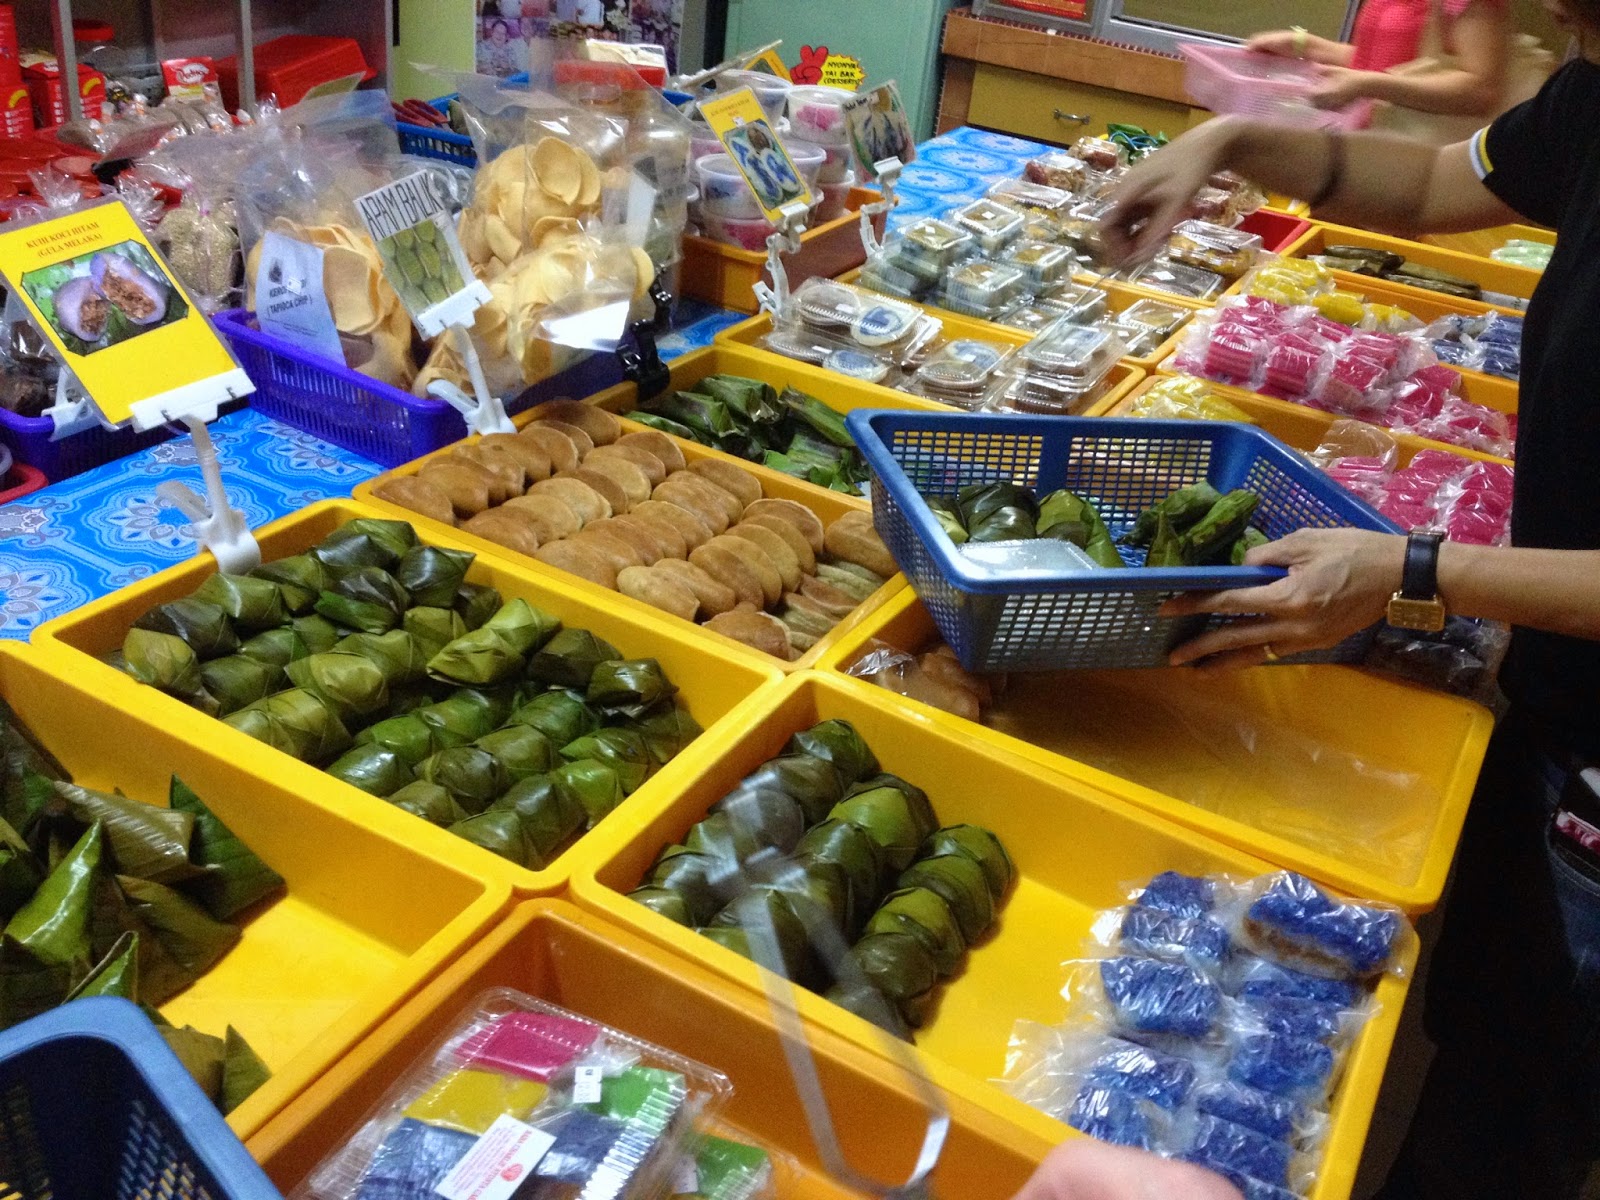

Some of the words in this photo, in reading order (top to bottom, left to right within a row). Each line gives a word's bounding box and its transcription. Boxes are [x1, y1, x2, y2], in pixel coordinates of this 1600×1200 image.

[359, 187, 408, 242] APAM
[395, 172, 443, 225] BALIK
[26, 236, 49, 248] KUIH
[49, 229, 72, 241] KOCI
[71, 221, 100, 235] HITAM
[38, 244, 64, 257] (GULA
[64, 233, 103, 248] MELAKA)
